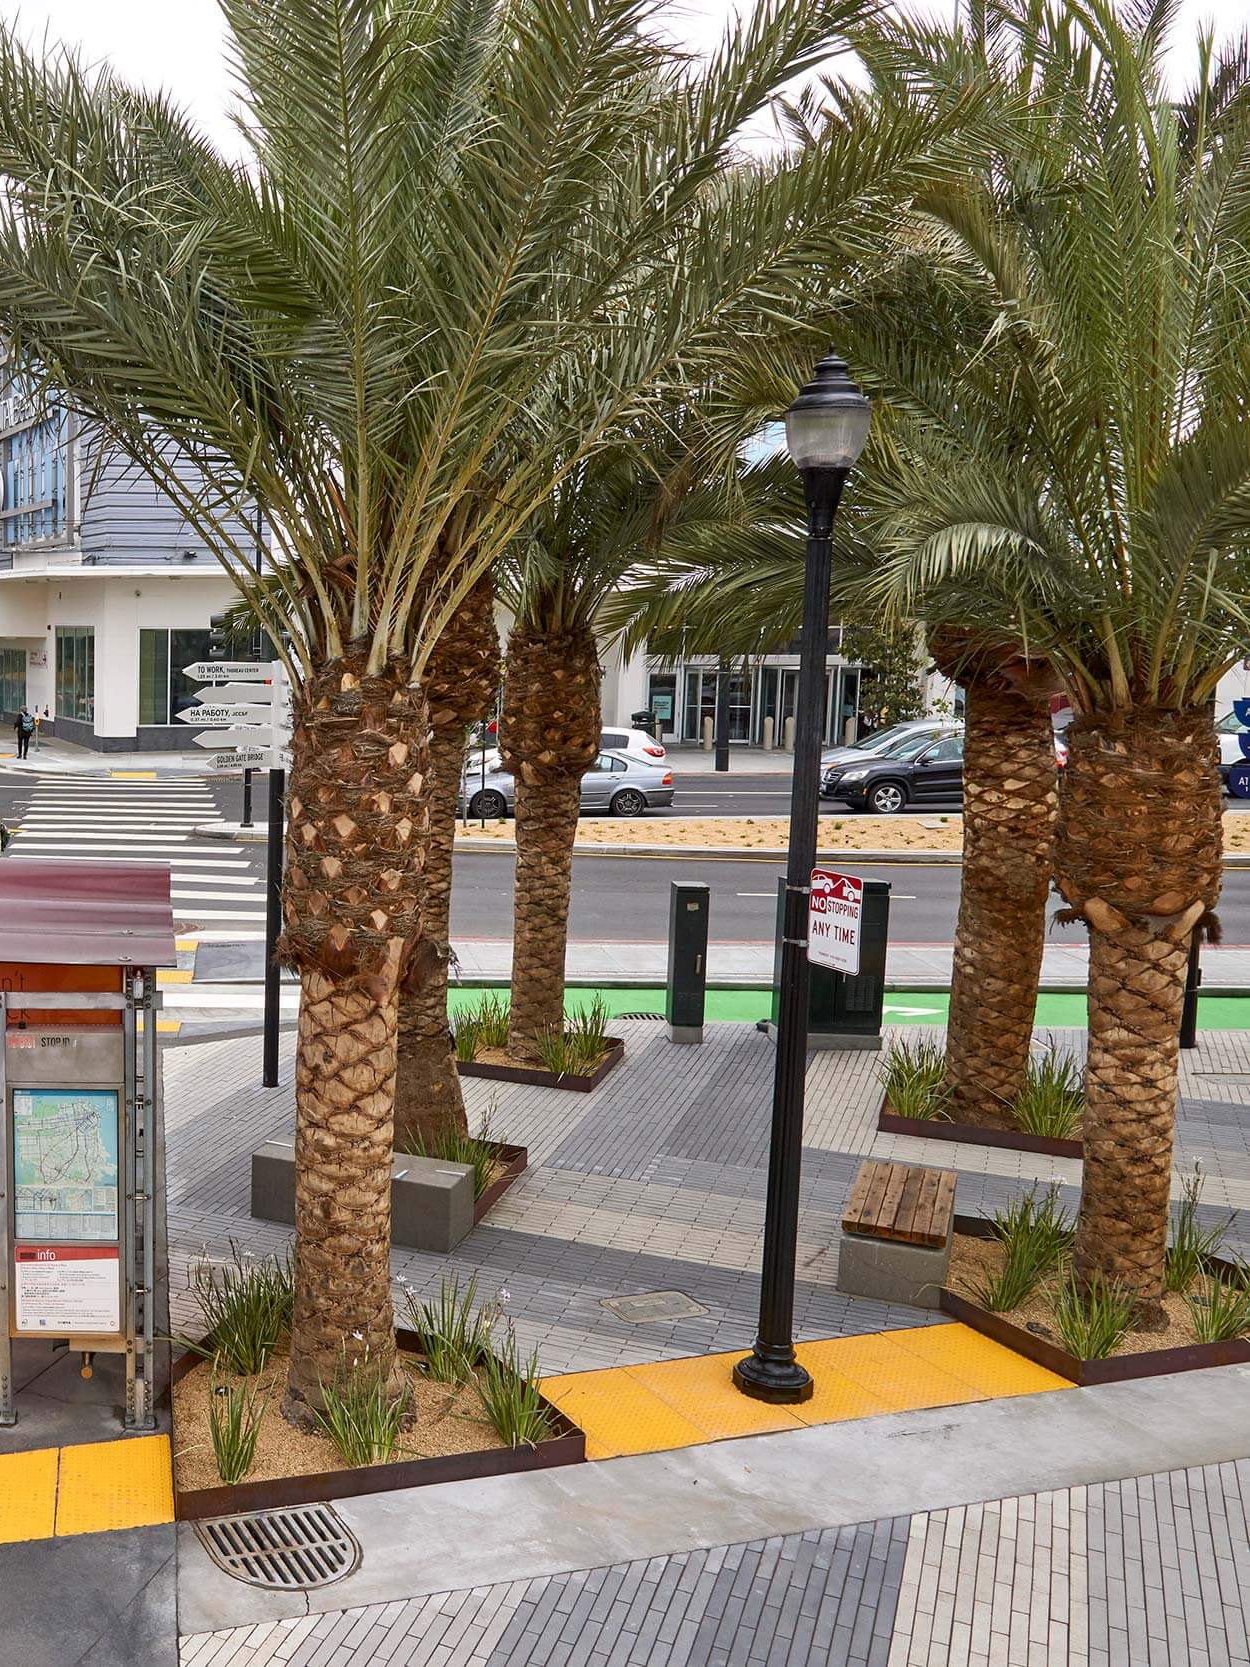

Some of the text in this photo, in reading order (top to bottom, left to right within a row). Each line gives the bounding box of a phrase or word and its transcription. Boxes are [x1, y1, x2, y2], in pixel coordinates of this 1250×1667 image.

[206, 666, 225, 674] WORK,
[190, 709, 201, 717] НА
[216, 753, 264, 764] GOLDEN GATE BRIDGE
[811, 895, 858, 919] NO STOPPING
[812, 919, 856, 945] ANY TIME
[37, 1248, 56, 1261] info
